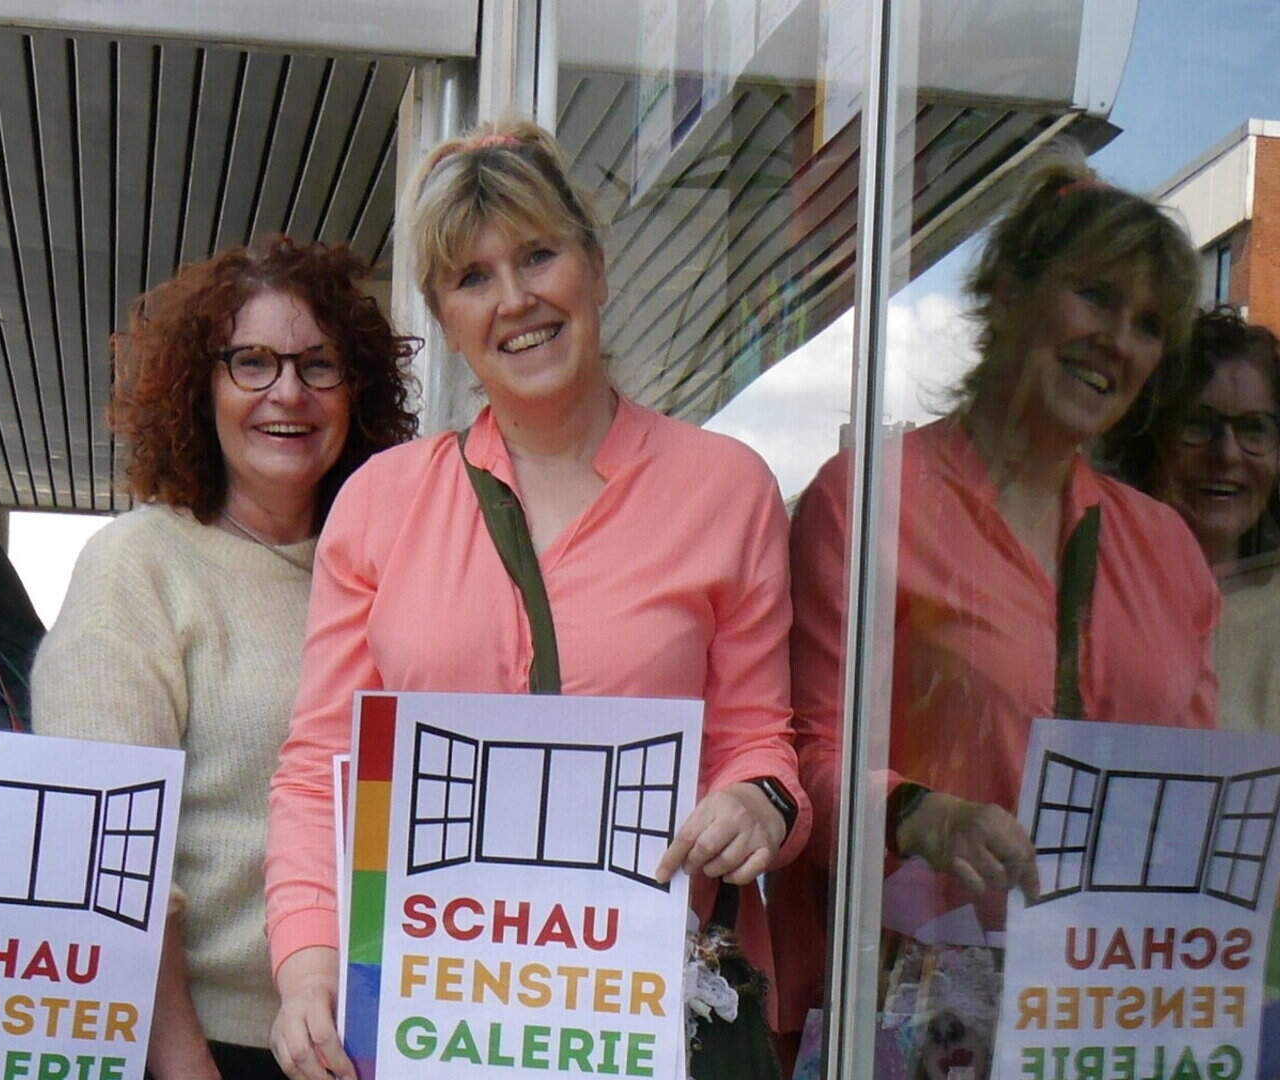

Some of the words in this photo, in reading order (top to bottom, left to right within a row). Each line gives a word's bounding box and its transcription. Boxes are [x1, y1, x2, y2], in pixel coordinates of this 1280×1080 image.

[402, 894, 619, 950] SCHAU
[401, 955, 666, 1016] FENSTER
[395, 1016, 656, 1077] GALERIE
